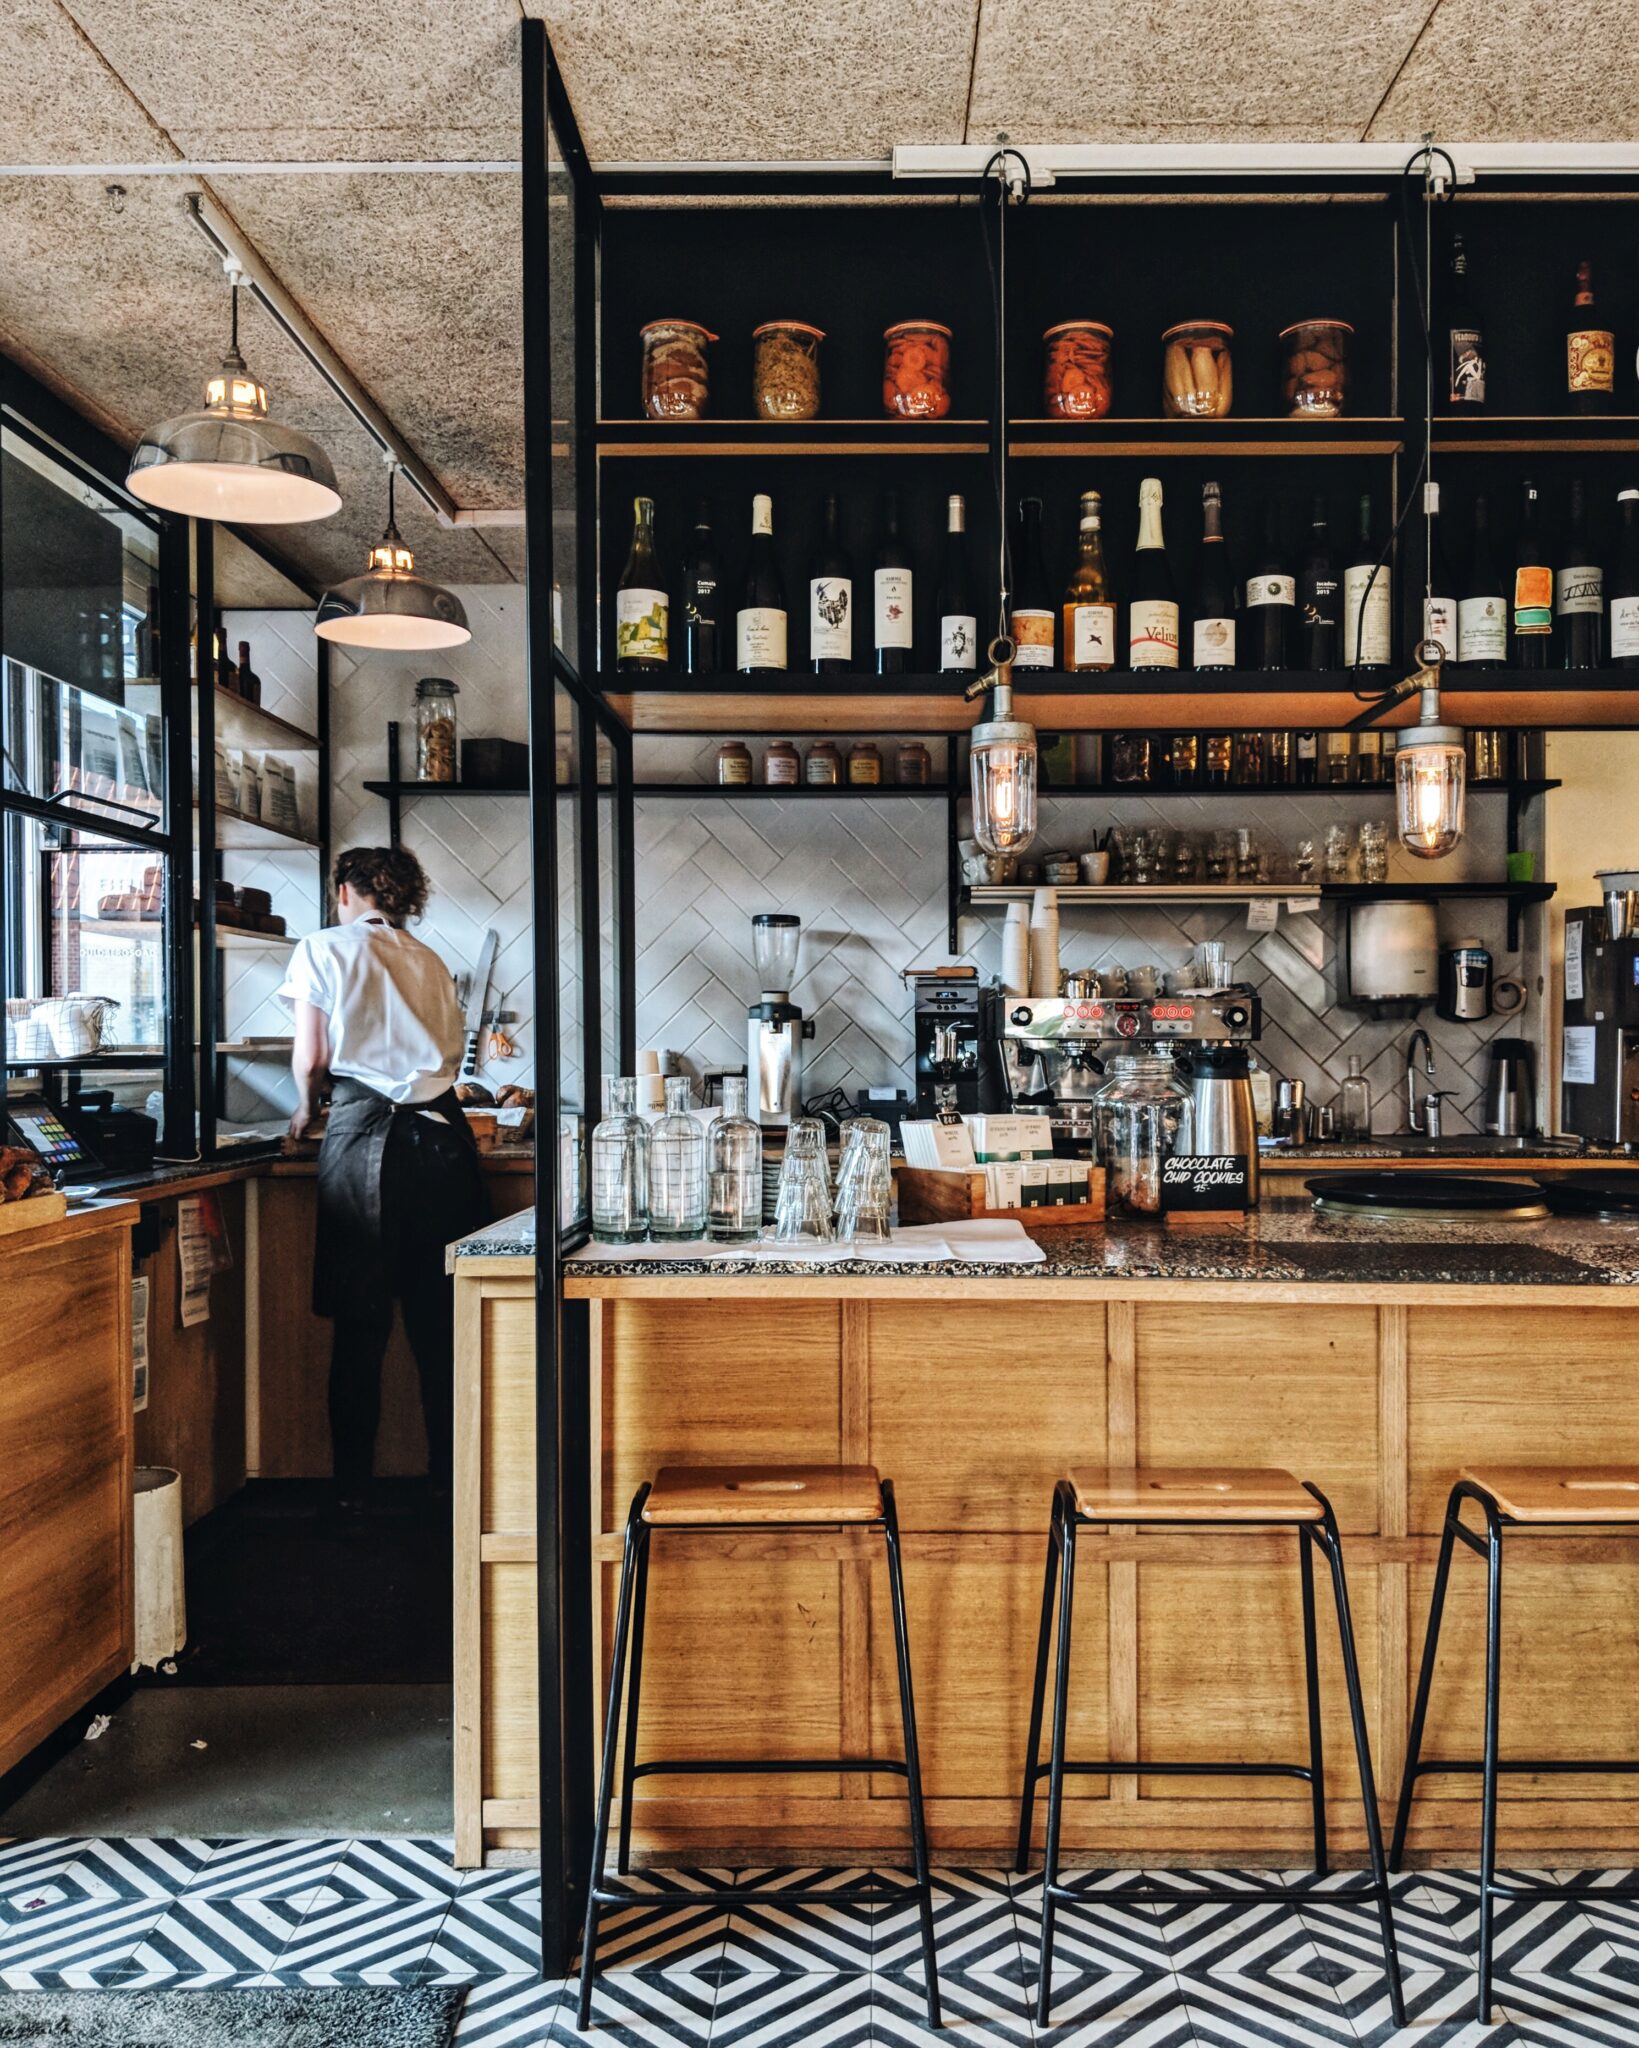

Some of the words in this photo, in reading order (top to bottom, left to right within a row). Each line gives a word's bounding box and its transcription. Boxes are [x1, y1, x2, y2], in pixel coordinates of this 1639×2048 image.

[1144, 626, 1177, 642] Velius
[1164, 1157, 1235, 1170] CHOCOLATE
[1163, 1170, 1192, 1184] CHIP
[1193, 1171, 1244, 1184] COOKIES
